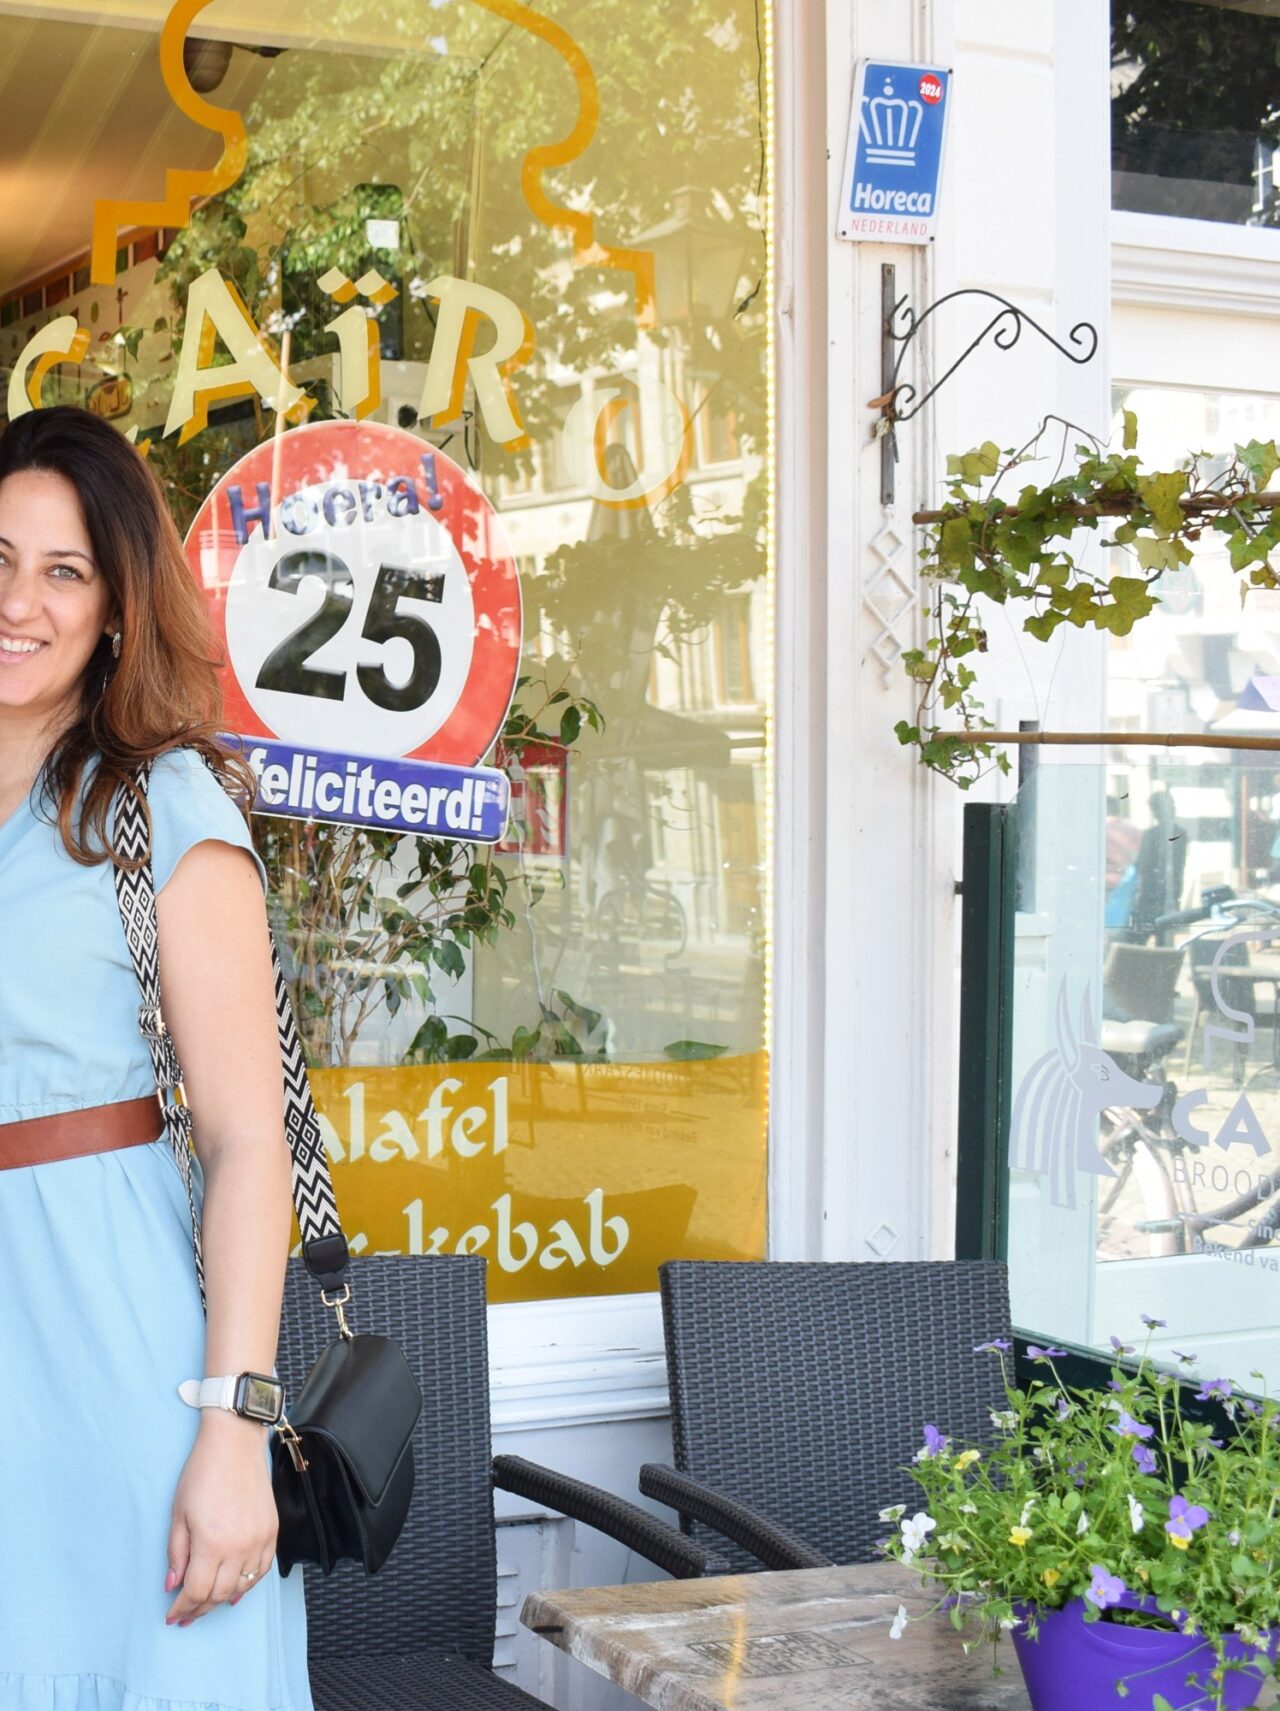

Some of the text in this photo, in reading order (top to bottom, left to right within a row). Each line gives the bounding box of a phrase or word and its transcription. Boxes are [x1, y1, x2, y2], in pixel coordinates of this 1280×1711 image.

[920, 82, 941, 98] 2024
[854, 183, 932, 214] Horeca
[851, 219, 928, 236] NEDERLAND
[227, 453, 444, 545] Hoera!
[255, 548, 446, 712] 25
[242, 747, 488, 832] feliciteerd!
[1192, 1233, 1254, 1267] Bekend
